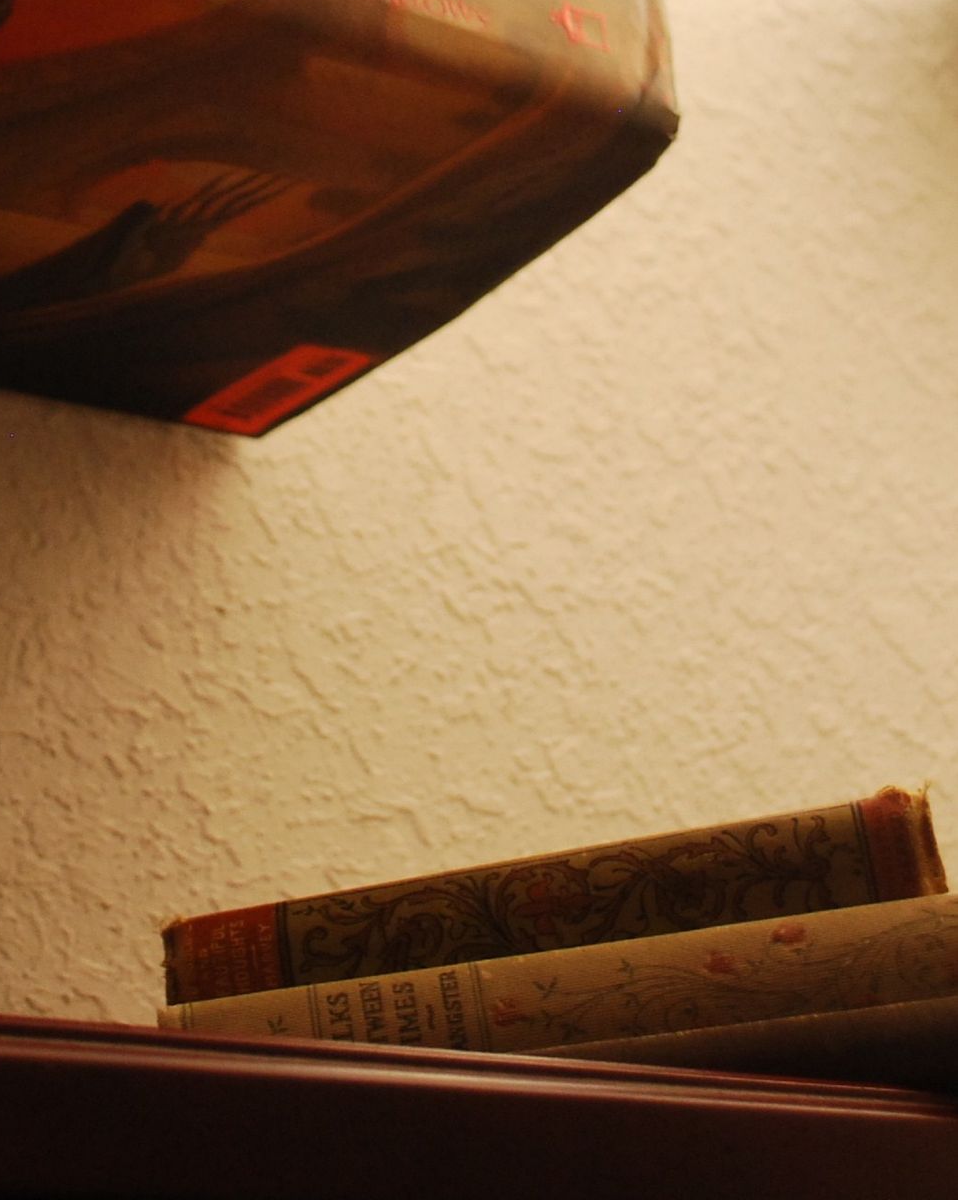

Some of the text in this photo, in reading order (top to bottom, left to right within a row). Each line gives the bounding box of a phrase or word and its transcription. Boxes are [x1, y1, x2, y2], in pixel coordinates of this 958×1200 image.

[326, 991, 356, 1042] LKS
[358, 980, 389, 1044] TWEEN
[393, 980, 423, 1046] IMES
[438, 970, 471, 1051] ANGSTER
